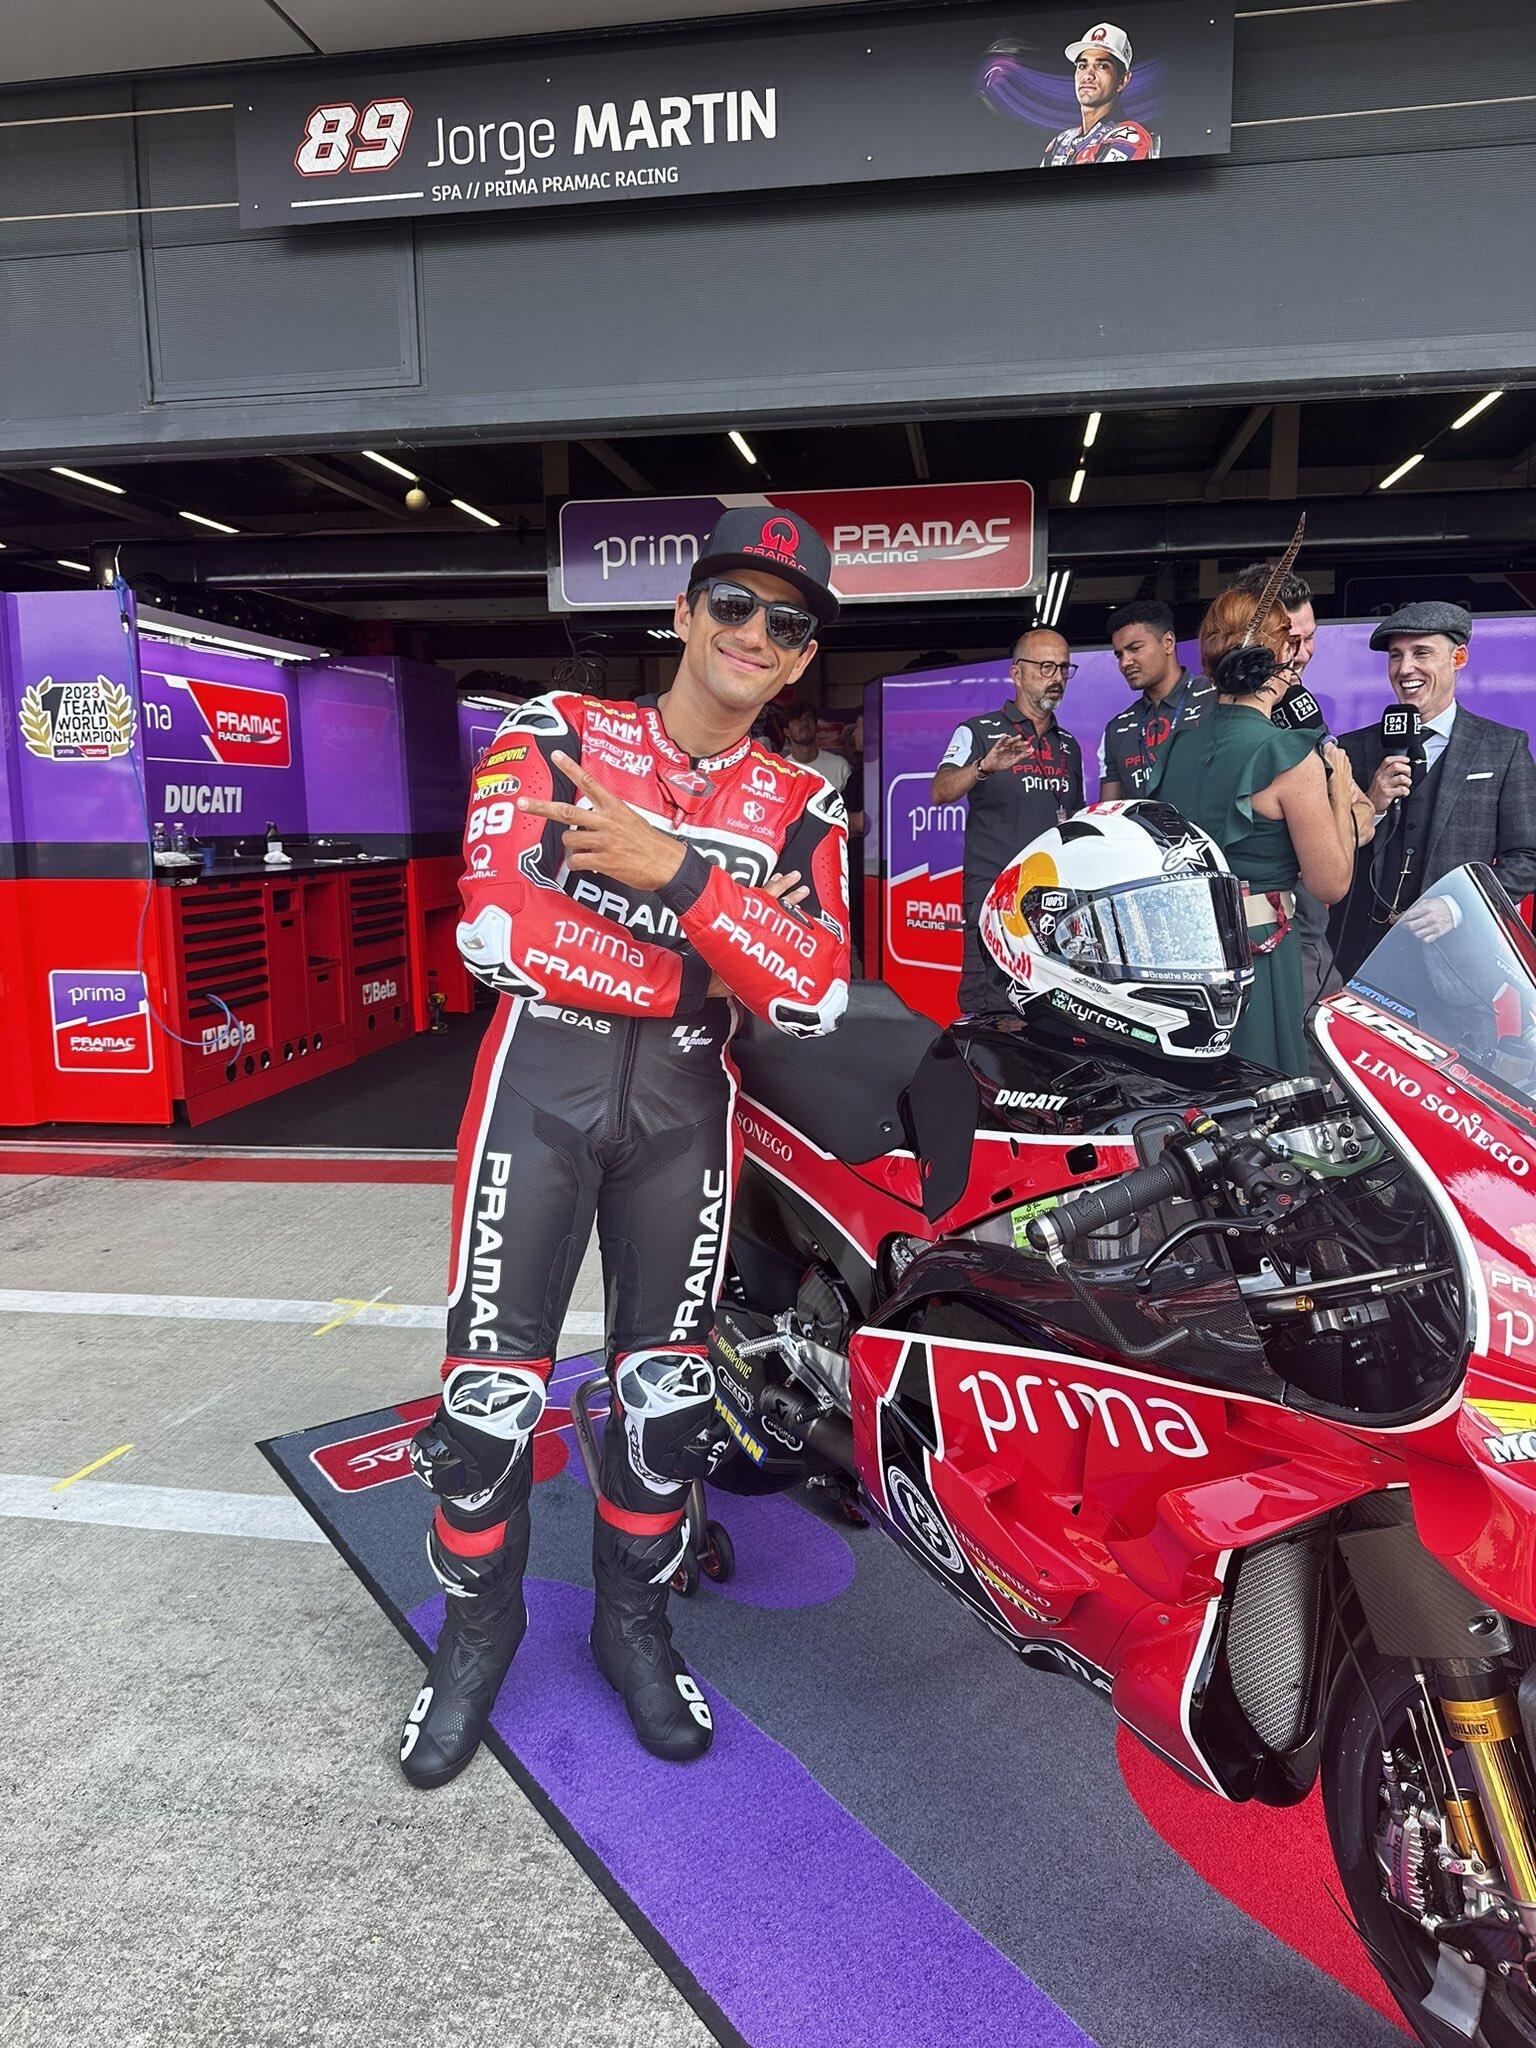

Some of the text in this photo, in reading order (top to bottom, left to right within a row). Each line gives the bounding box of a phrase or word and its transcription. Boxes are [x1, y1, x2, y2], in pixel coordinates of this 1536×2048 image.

[293, 97, 414, 178] 89
[427, 87, 777, 176] Jorge MARTIN
[432, 184, 463, 202] SPA
[485, 179, 539, 198] PRIMA
[541, 172, 611, 194] PRAMAC
[615, 166, 679, 187] RACING
[833, 517, 1012, 551] PRAMAC
[593, 533, 713, 580] prim
[834, 550, 919, 566] RACING
[63, 700, 108, 716] TEAM
[65, 686, 100, 699] 2023
[55, 731, 122, 743] CHAMPION
[58, 716, 108, 730] WORLD
[216, 710, 283, 736] PRAMAC
[217, 731, 252, 743] RACING
[586, 710, 643, 743] FIAMM
[645, 711, 684, 764] PRAMAC
[164, 784, 243, 814] DUCATI
[741, 783, 786, 804] PRAMAC
[467, 801, 515, 844] 89
[908, 806, 967, 842] prim
[1199, 870, 1219, 879] YOU
[572, 878, 688, 939] PRAM
[906, 900, 963, 922] PRAM
[1044, 896, 1064, 907] 100%
[742, 896, 818, 960] prima
[906, 919, 946, 931] RACING
[554, 920, 646, 969] prima
[711, 913, 816, 999] PRAMAC
[371, 980, 397, 1001] Beta
[523, 947, 656, 1008] PRAMAC
[1149, 969, 1182, 980] Breathe
[1182, 971, 1206, 982] Right
[68, 986, 127, 1005] prima
[217, 1022, 256, 1048] Beta
[561, 1010, 612, 1035] GAS
[70, 1036, 136, 1050] PRAMAC
[993, 1089, 1068, 1112] DUCATI
[1351, 1050, 1422, 1098] LINO
[1420, 1093, 1530, 1177] SONEGO
[736, 1110, 793, 1162] SONEGO
[469, 1151, 512, 1352] PRAMAC
[669, 1168, 725, 1342] PRAMAC
[716, 1336, 753, 1380] AKRAPOVIC
[714, 1393, 764, 1462] HELIN
[958, 1370, 1210, 1459] prima
[986, 1556, 1052, 1608] SONEGO
